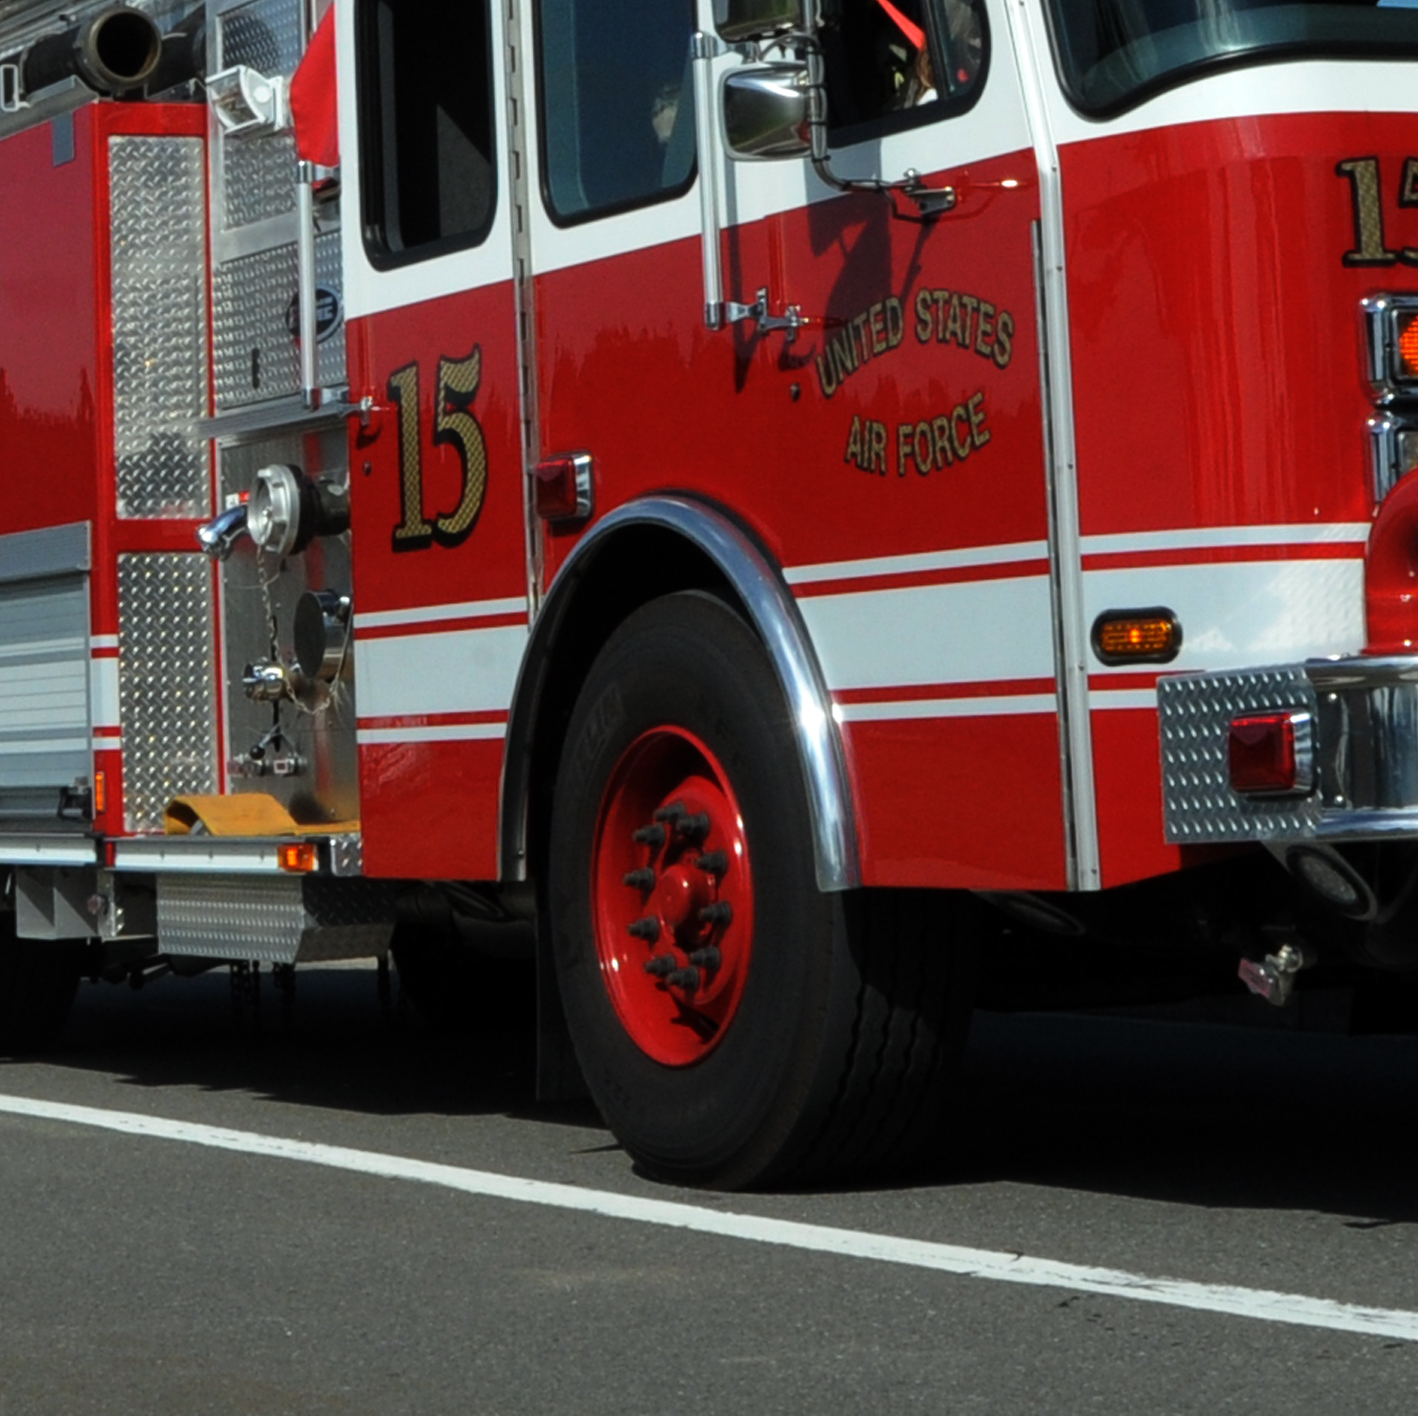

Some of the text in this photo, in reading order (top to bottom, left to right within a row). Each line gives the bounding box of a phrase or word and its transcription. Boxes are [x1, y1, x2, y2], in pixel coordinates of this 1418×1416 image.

[816, 288, 1015, 399] UNITED STATES
[387, 344, 488, 553] 15
[844, 391, 991, 477] AIR FORCE
